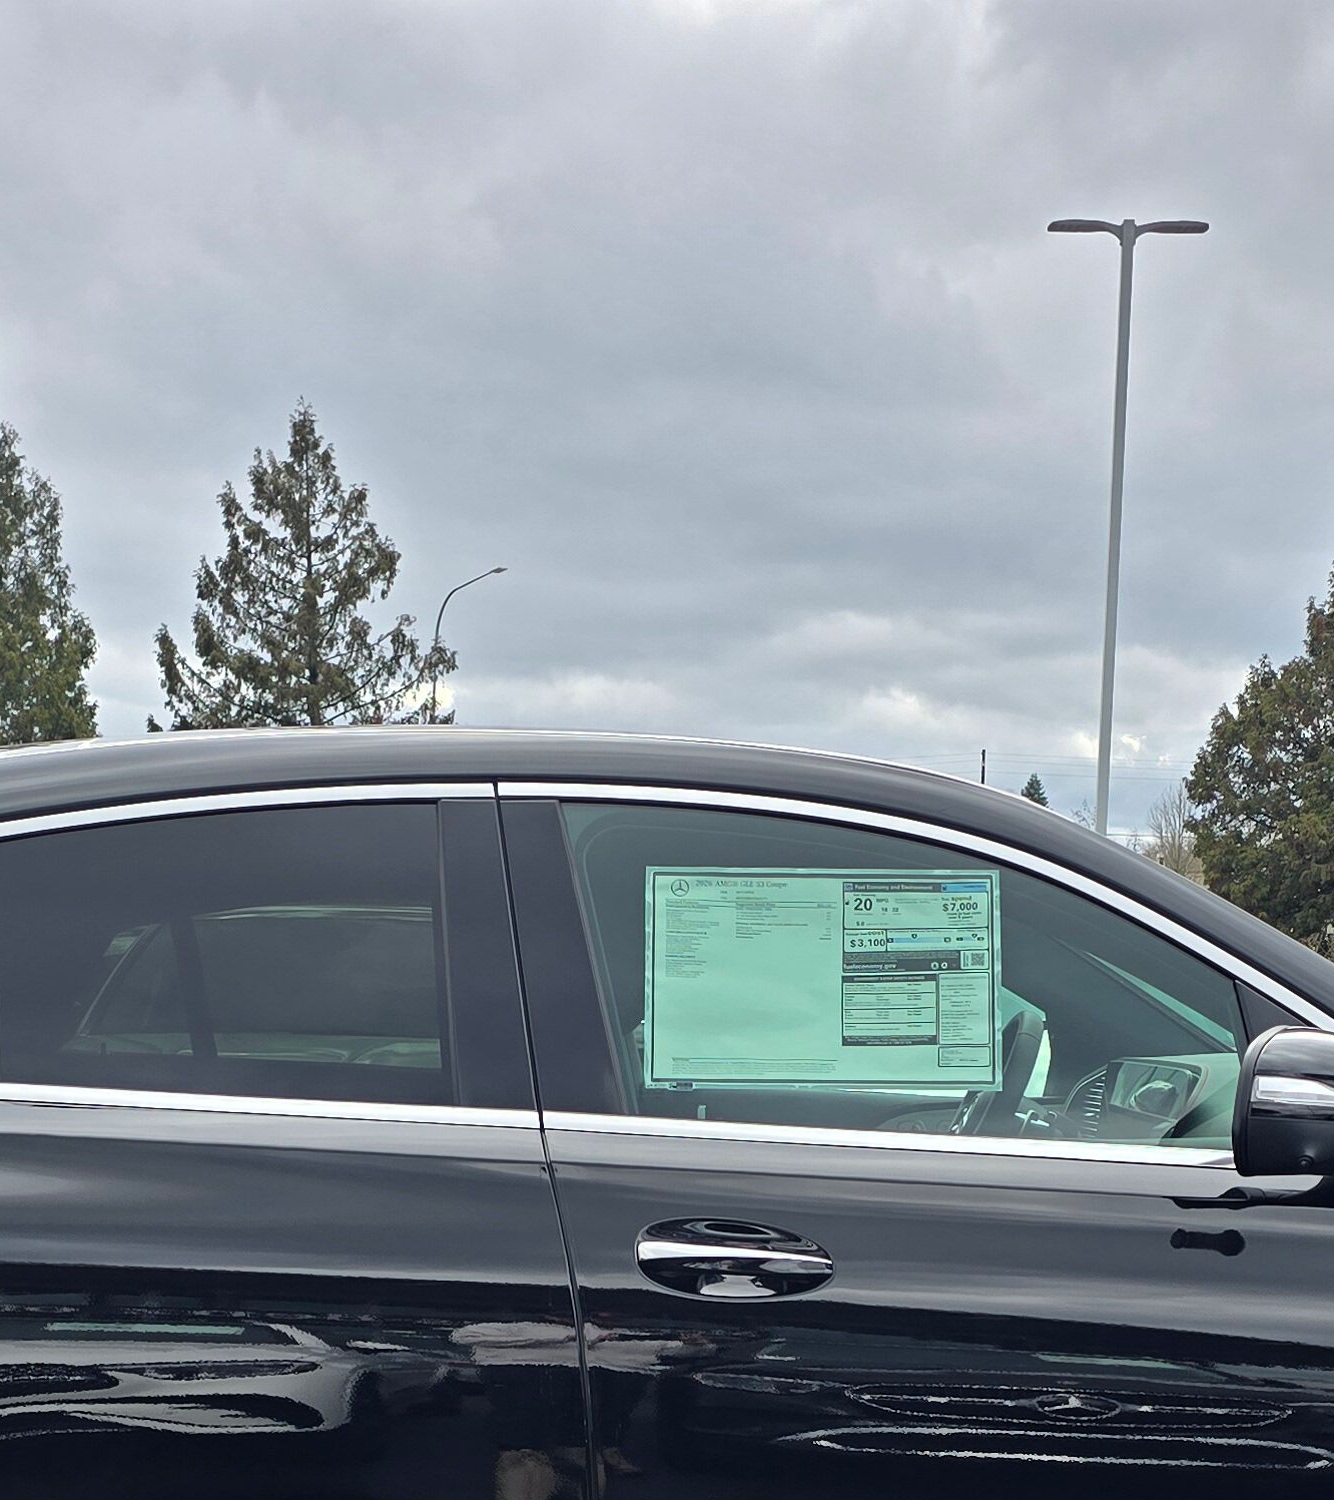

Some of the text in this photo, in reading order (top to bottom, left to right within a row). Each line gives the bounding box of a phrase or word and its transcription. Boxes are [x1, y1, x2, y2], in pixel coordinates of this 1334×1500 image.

[853, 898, 873, 911] 20
[942, 901, 979, 913] $7,000
[850, 938, 886, 948] $3,100
